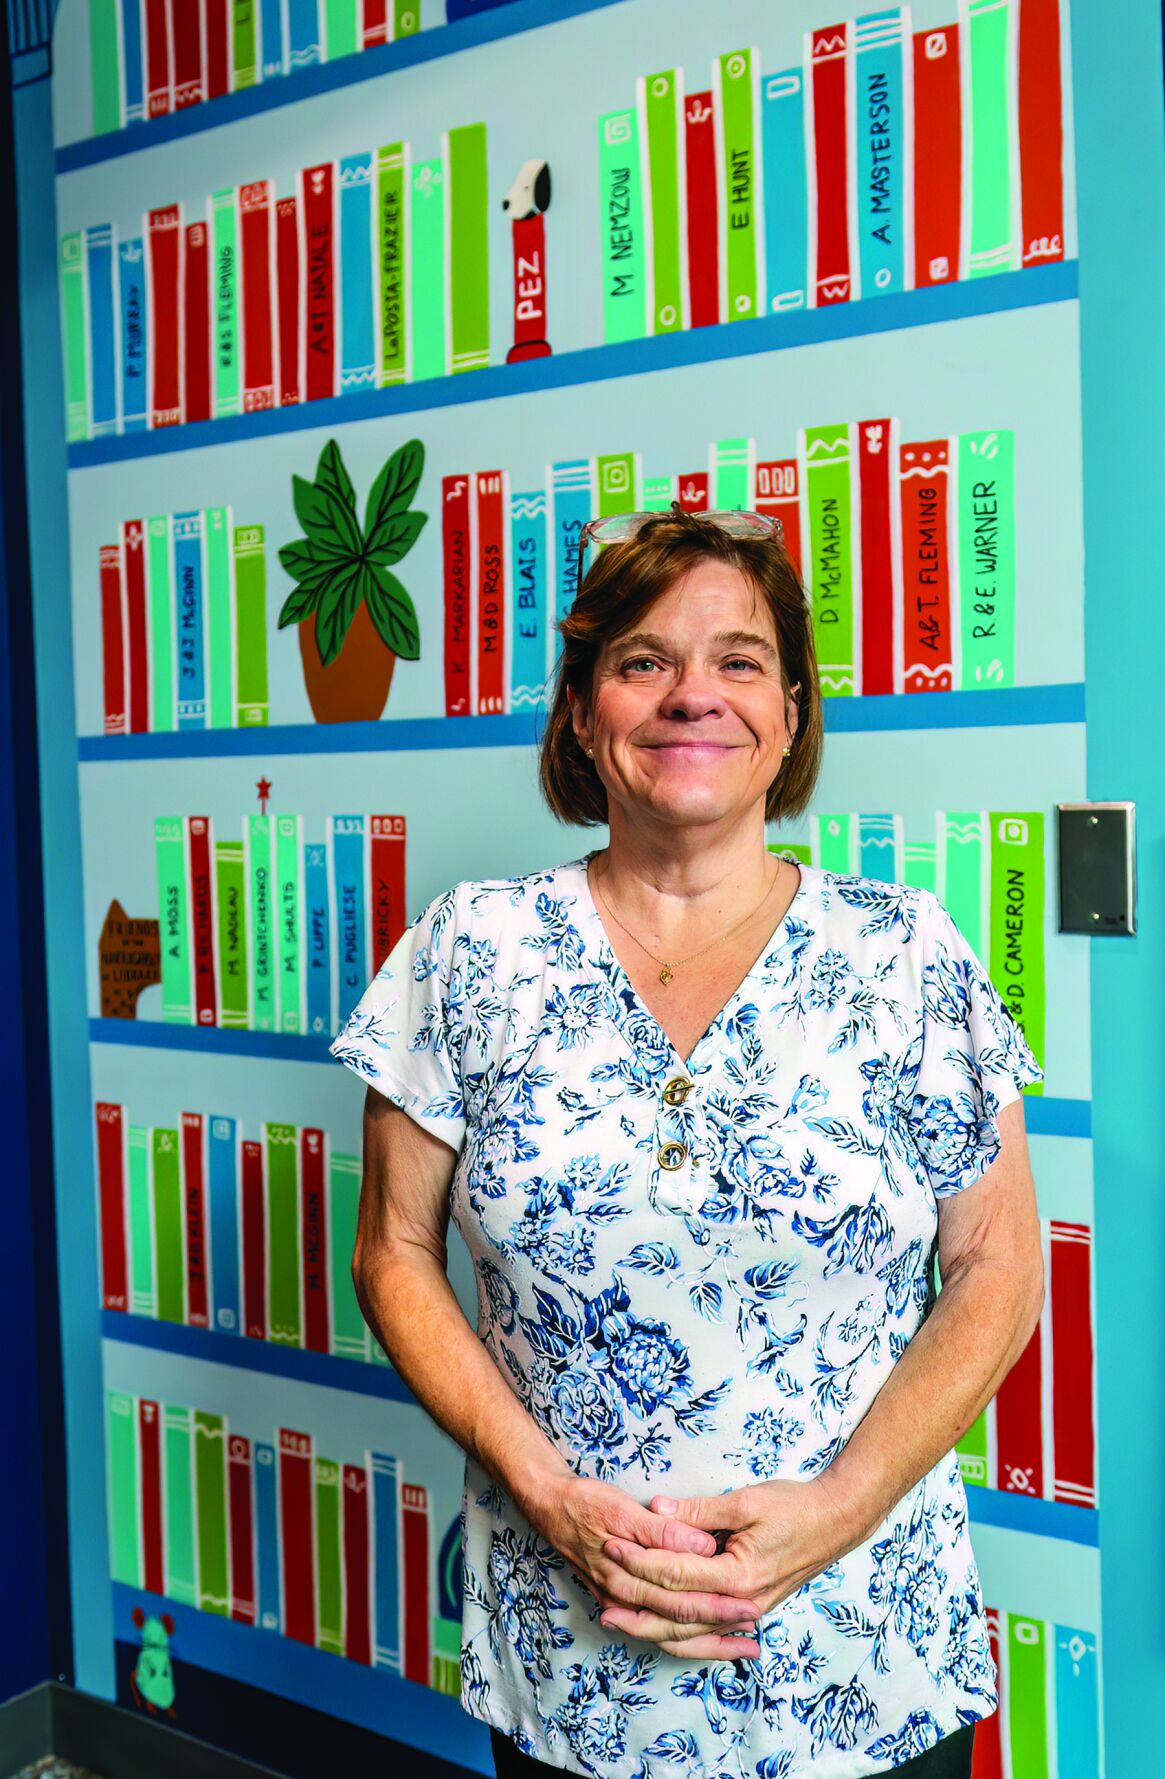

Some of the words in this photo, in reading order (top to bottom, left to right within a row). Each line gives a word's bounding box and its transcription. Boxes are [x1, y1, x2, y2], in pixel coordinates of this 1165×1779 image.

[731, 148, 751, 203] HUNT
[868, 73, 891, 213] MASTERSON
[610, 167, 633, 261] NEMZOW
[217, 246, 233, 325] FLEMING
[383, 190, 400, 360] LaPOSTA-FRAZIER
[516, 251, 543, 321] PEZ
[562, 519, 582, 594] HAMES
[820, 498, 841, 600] McMAHON
[918, 487, 940, 584] FLEMING
[972, 480, 998, 575] WARNER
[452, 530, 465, 642] MARKARIAN
[484, 544, 499, 594] ROSS
[518, 537, 537, 609] BLAIS
[973, 602, 995, 616] &
[167, 885, 180, 936] MOSS
[312, 907, 326, 953] LIPPE
[342, 884, 357, 964] PUGLIESE
[1004, 868, 1025, 976] CAMERON
[168, 945, 180, 959] A
[284, 957, 296, 974] M
